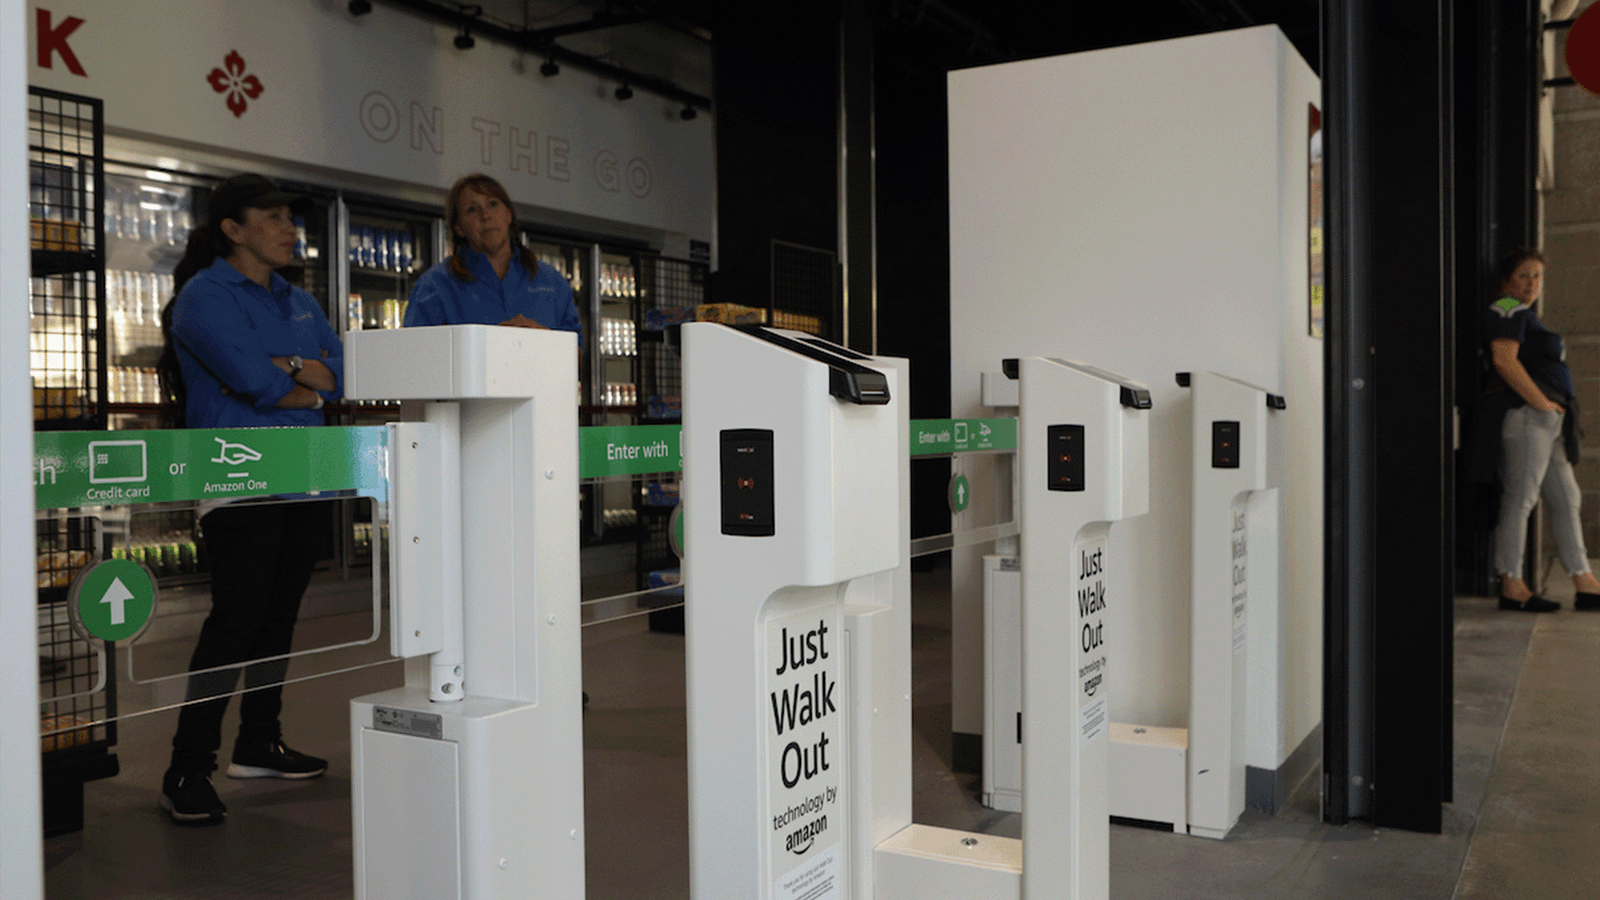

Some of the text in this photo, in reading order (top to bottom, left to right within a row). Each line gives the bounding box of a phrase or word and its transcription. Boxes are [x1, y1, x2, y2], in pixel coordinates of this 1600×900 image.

[36, 8, 87, 77] K
[358, 89, 651, 199] ON THE GO
[169, 462, 187, 475] or
[607, 440, 668, 460] Enter with
[34, 458, 56, 485] h
[203, 480, 267, 493] Amazon One
[86, 485, 150, 500] Credit card
[1080, 547, 1103, 580] Just
[1078, 580, 1107, 618] Walk
[776, 619, 829, 675] Just
[1081, 619, 1103, 653] Out
[771, 671, 836, 735] Walk
[781, 731, 829, 789] Out
[773, 785, 838, 831] technology by
[785, 814, 828, 852] amazon
